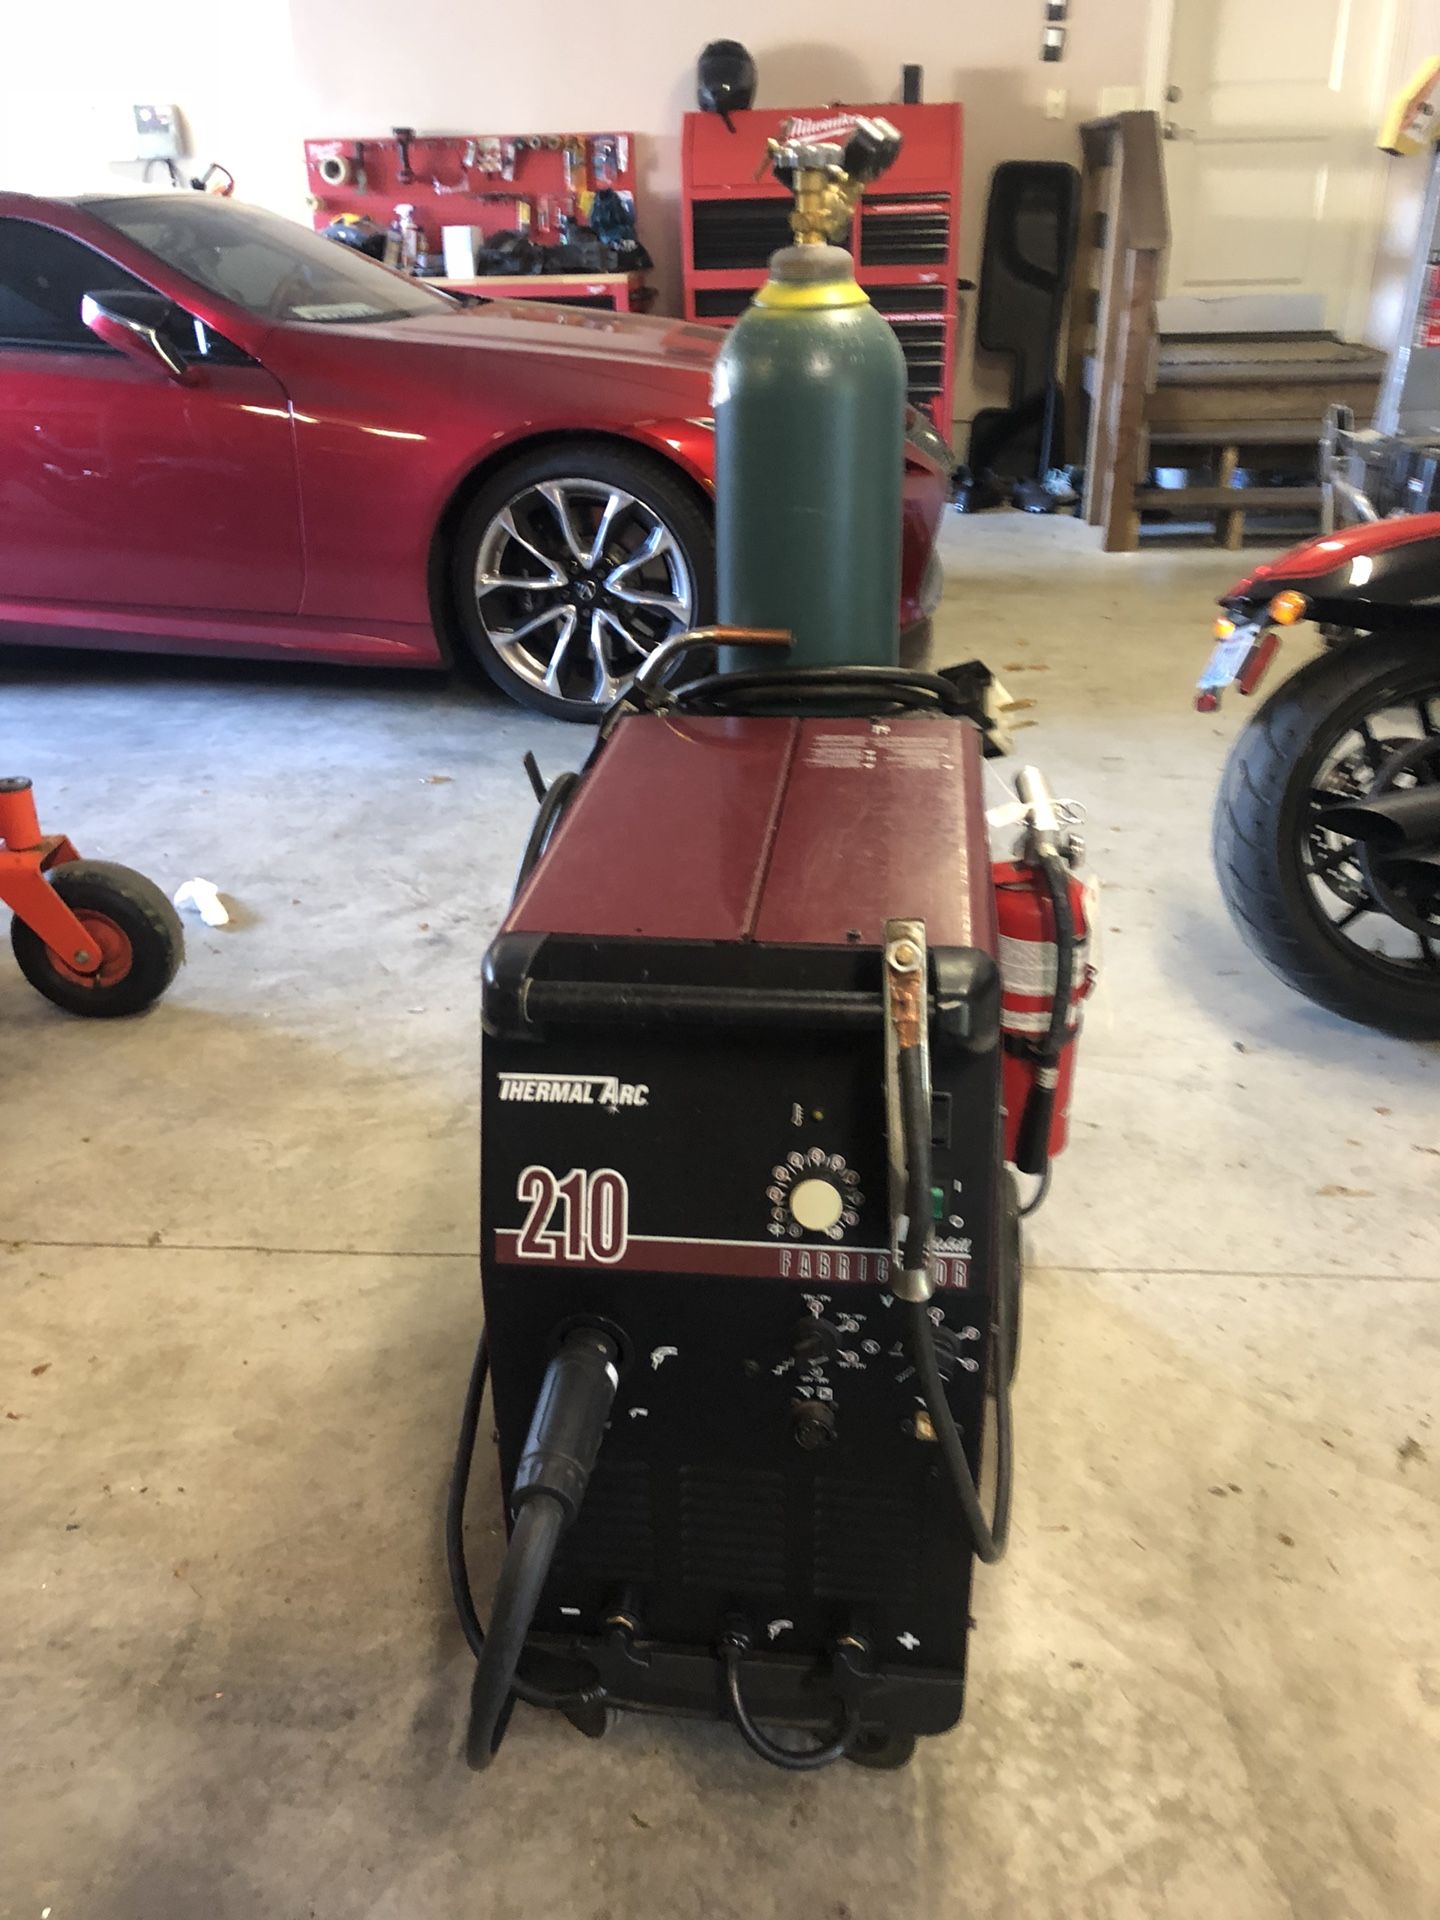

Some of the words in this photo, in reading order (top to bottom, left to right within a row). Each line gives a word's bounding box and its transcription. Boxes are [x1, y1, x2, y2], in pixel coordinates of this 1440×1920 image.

[789, 112, 858, 139] Milwauke
[498, 1072, 594, 1104] THERMAL
[597, 1075, 650, 1107] ARC
[516, 1165, 629, 1264] 210
[779, 1249, 968, 1289] FABRICOR
